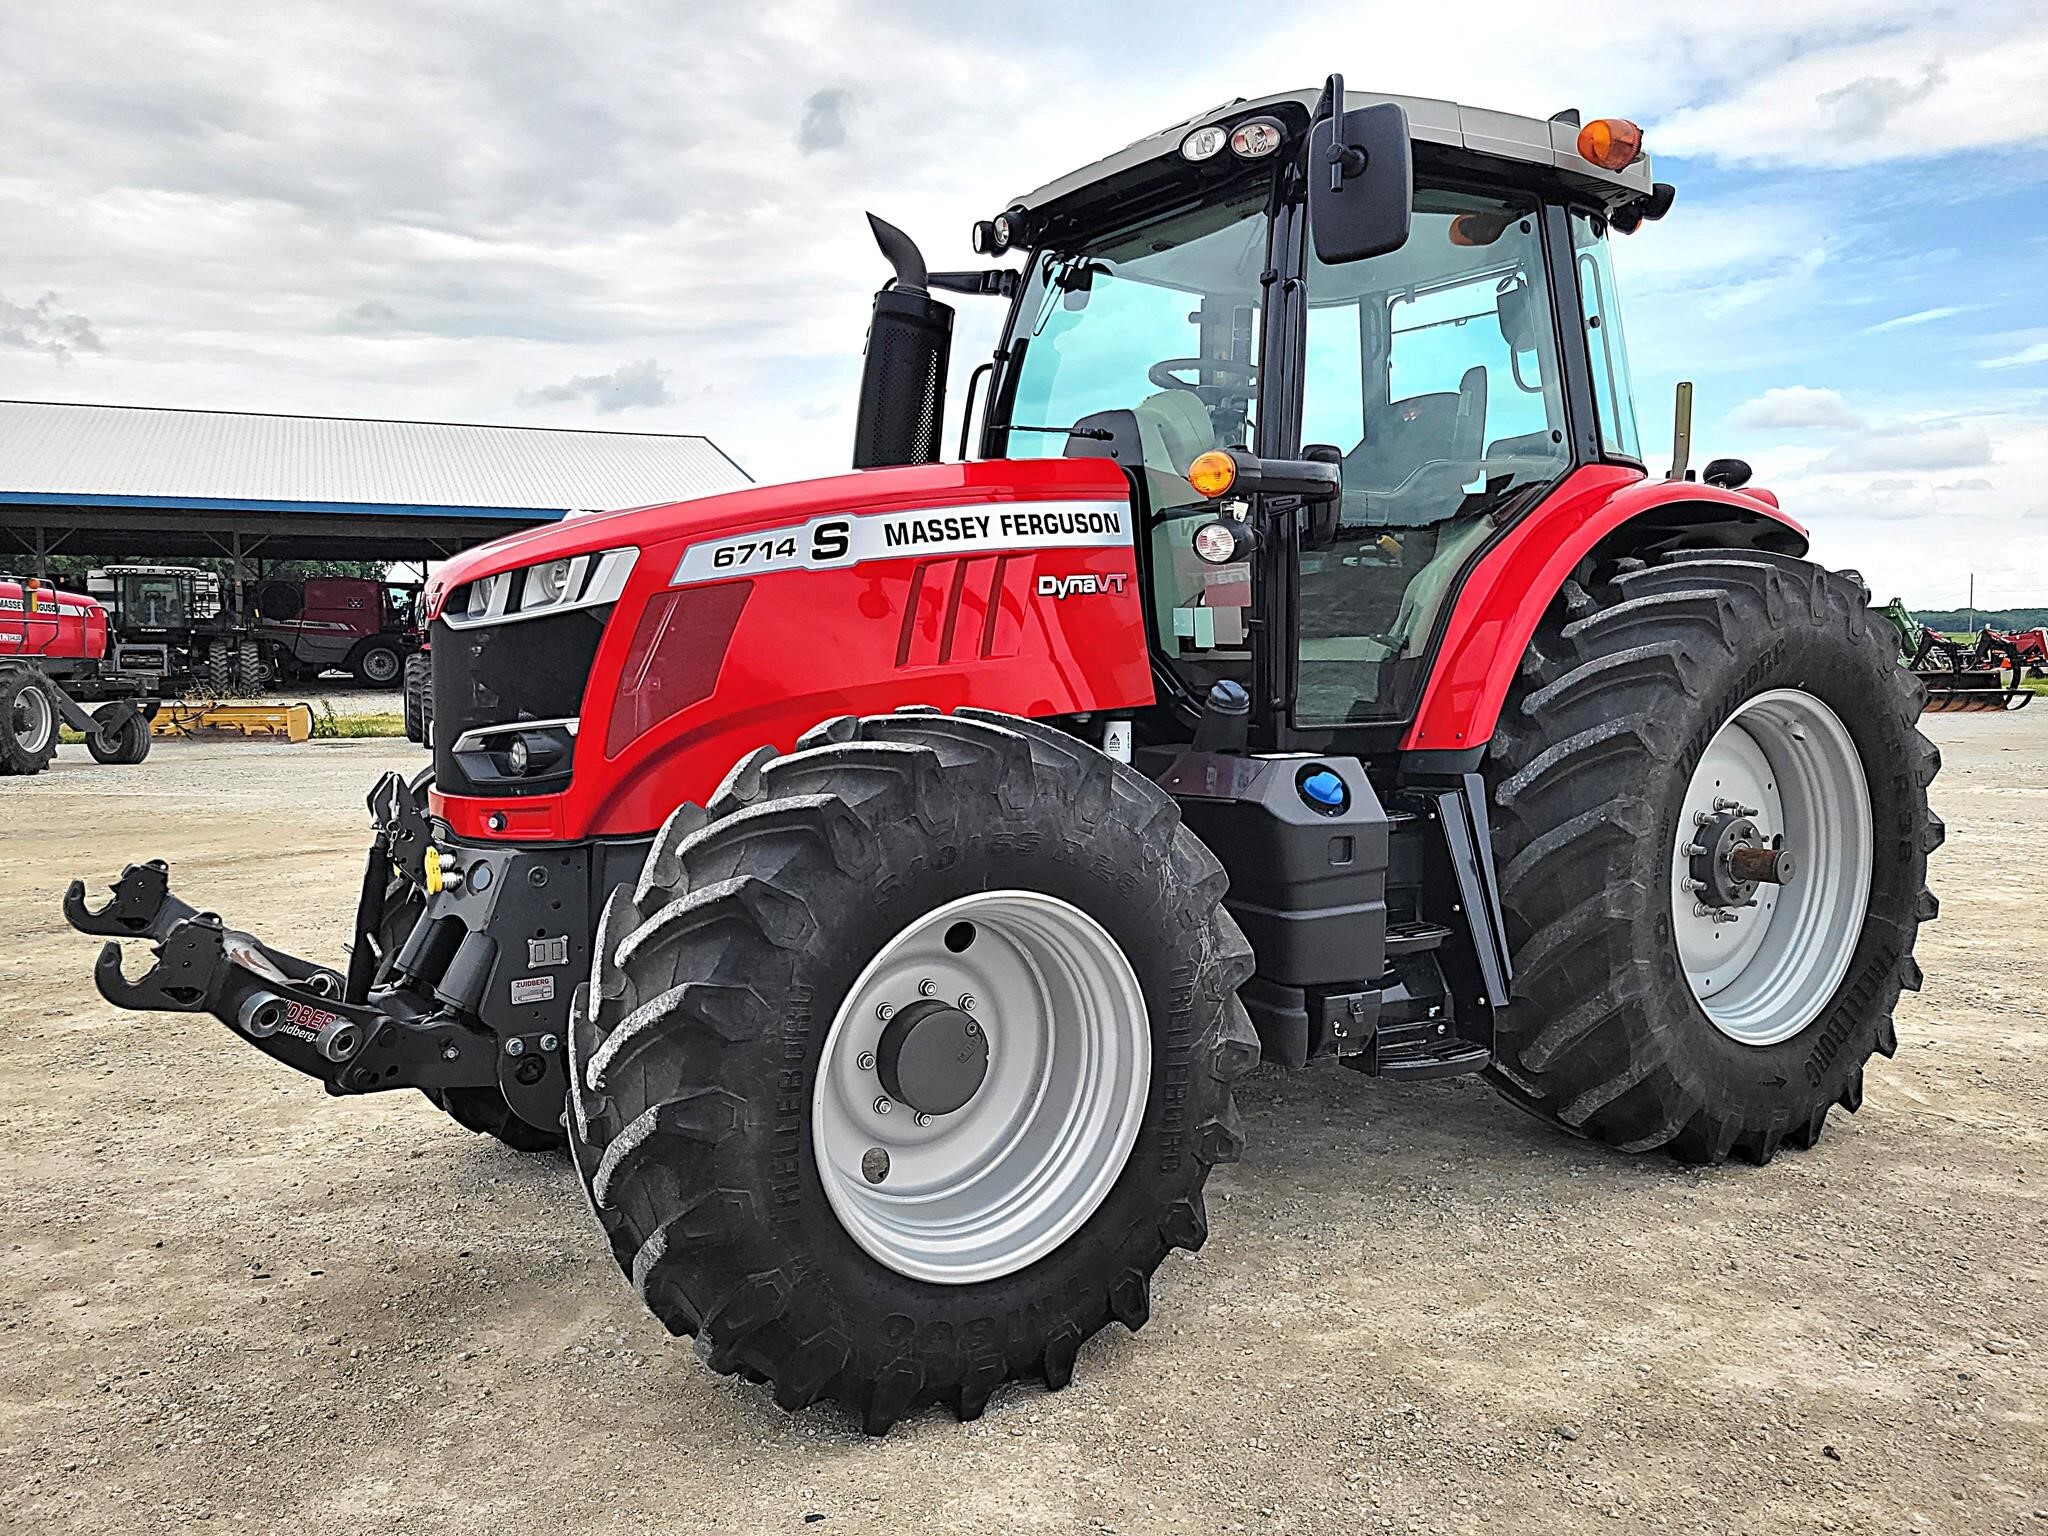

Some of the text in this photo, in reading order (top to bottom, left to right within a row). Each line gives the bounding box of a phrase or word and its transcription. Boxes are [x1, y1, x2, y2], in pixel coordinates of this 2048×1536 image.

[713, 511, 1122, 568] 6714 S MASSEY FERGUSON
[1037, 573, 1128, 599] DynaVT
[515, 978, 551, 988] ZUIDBERG
[283, 1000, 337, 1032] DBER
